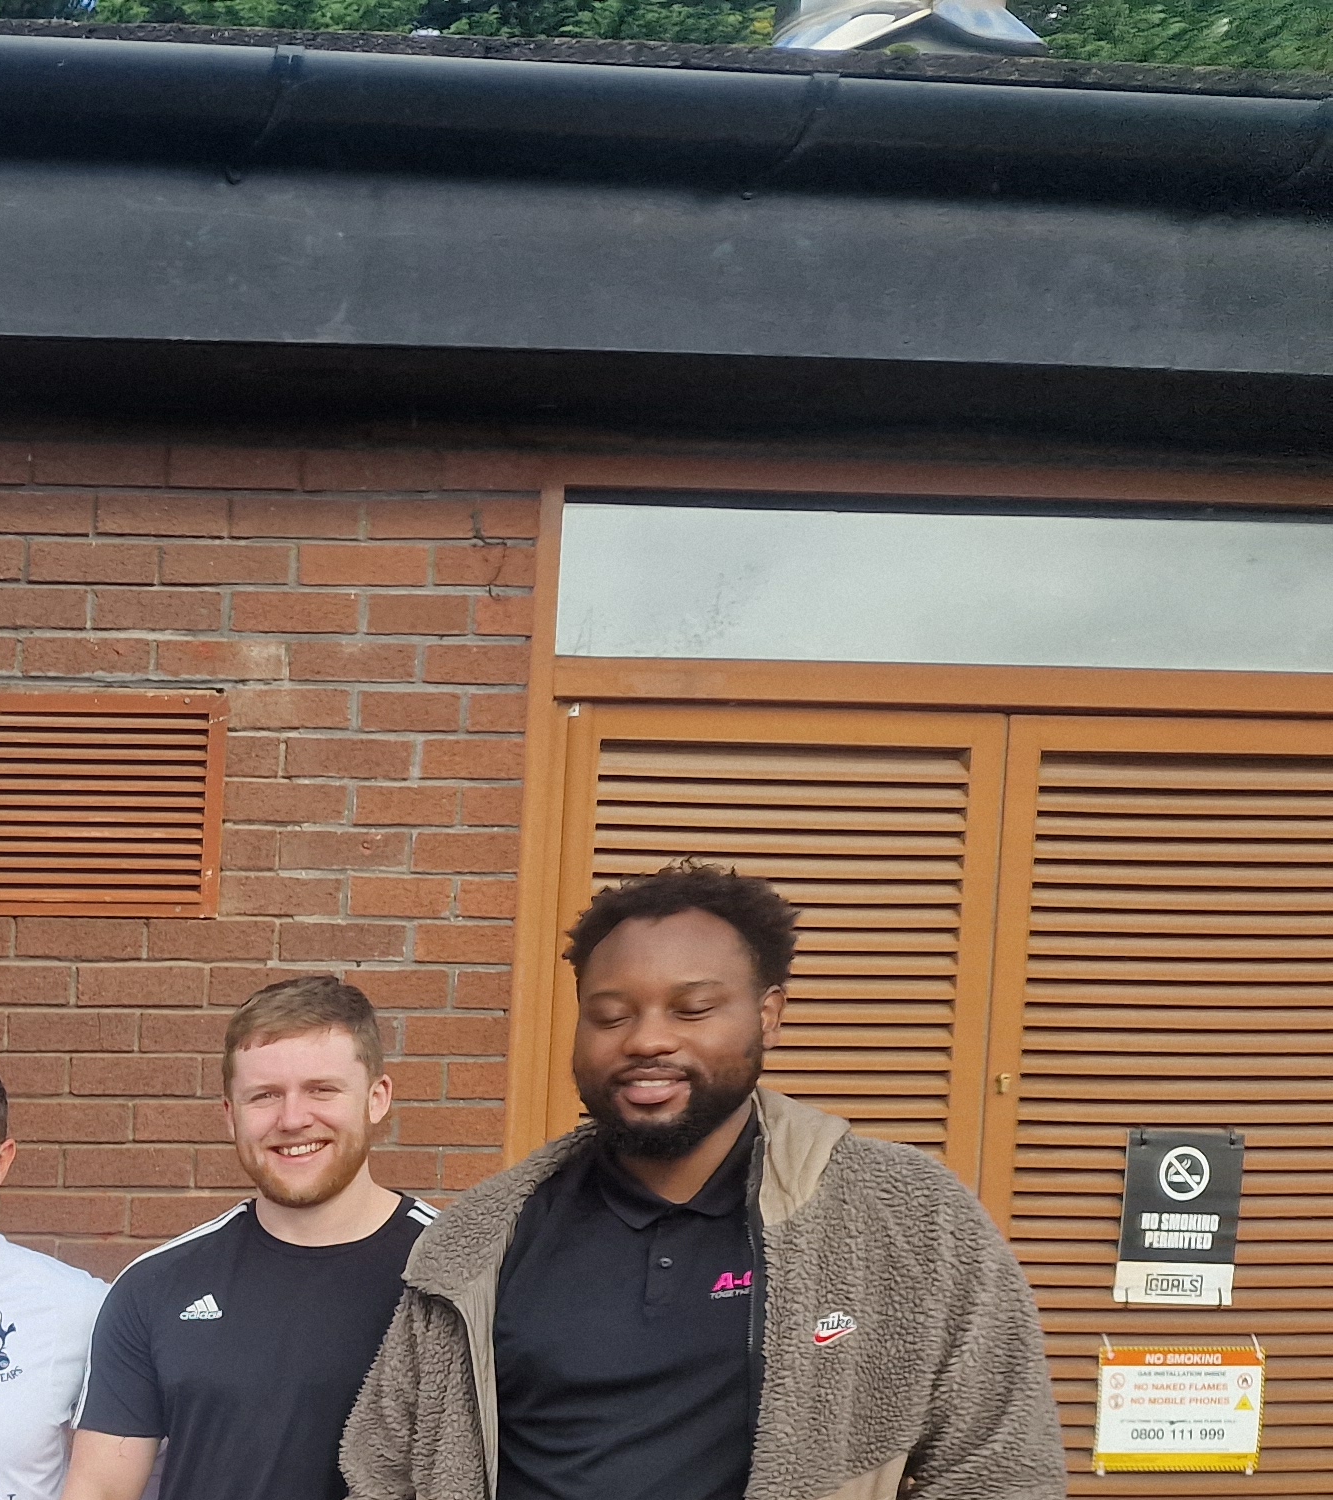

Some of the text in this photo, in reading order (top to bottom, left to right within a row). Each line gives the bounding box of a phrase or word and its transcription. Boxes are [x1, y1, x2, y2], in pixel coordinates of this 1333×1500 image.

[1141, 1212, 1160, 1230] NO
[1148, 1277, 1200, 1293] GOALS
[819, 1312, 853, 1331] nike
[1145, 1353, 1222, 1365] NO SMOKING
[1134, 1382, 1229, 1392] NO NAKED FLAMES
[1130, 1396, 1231, 1406] NO MOBILE PHONES
[1130, 1428, 1225, 1440] 0800 111 999
